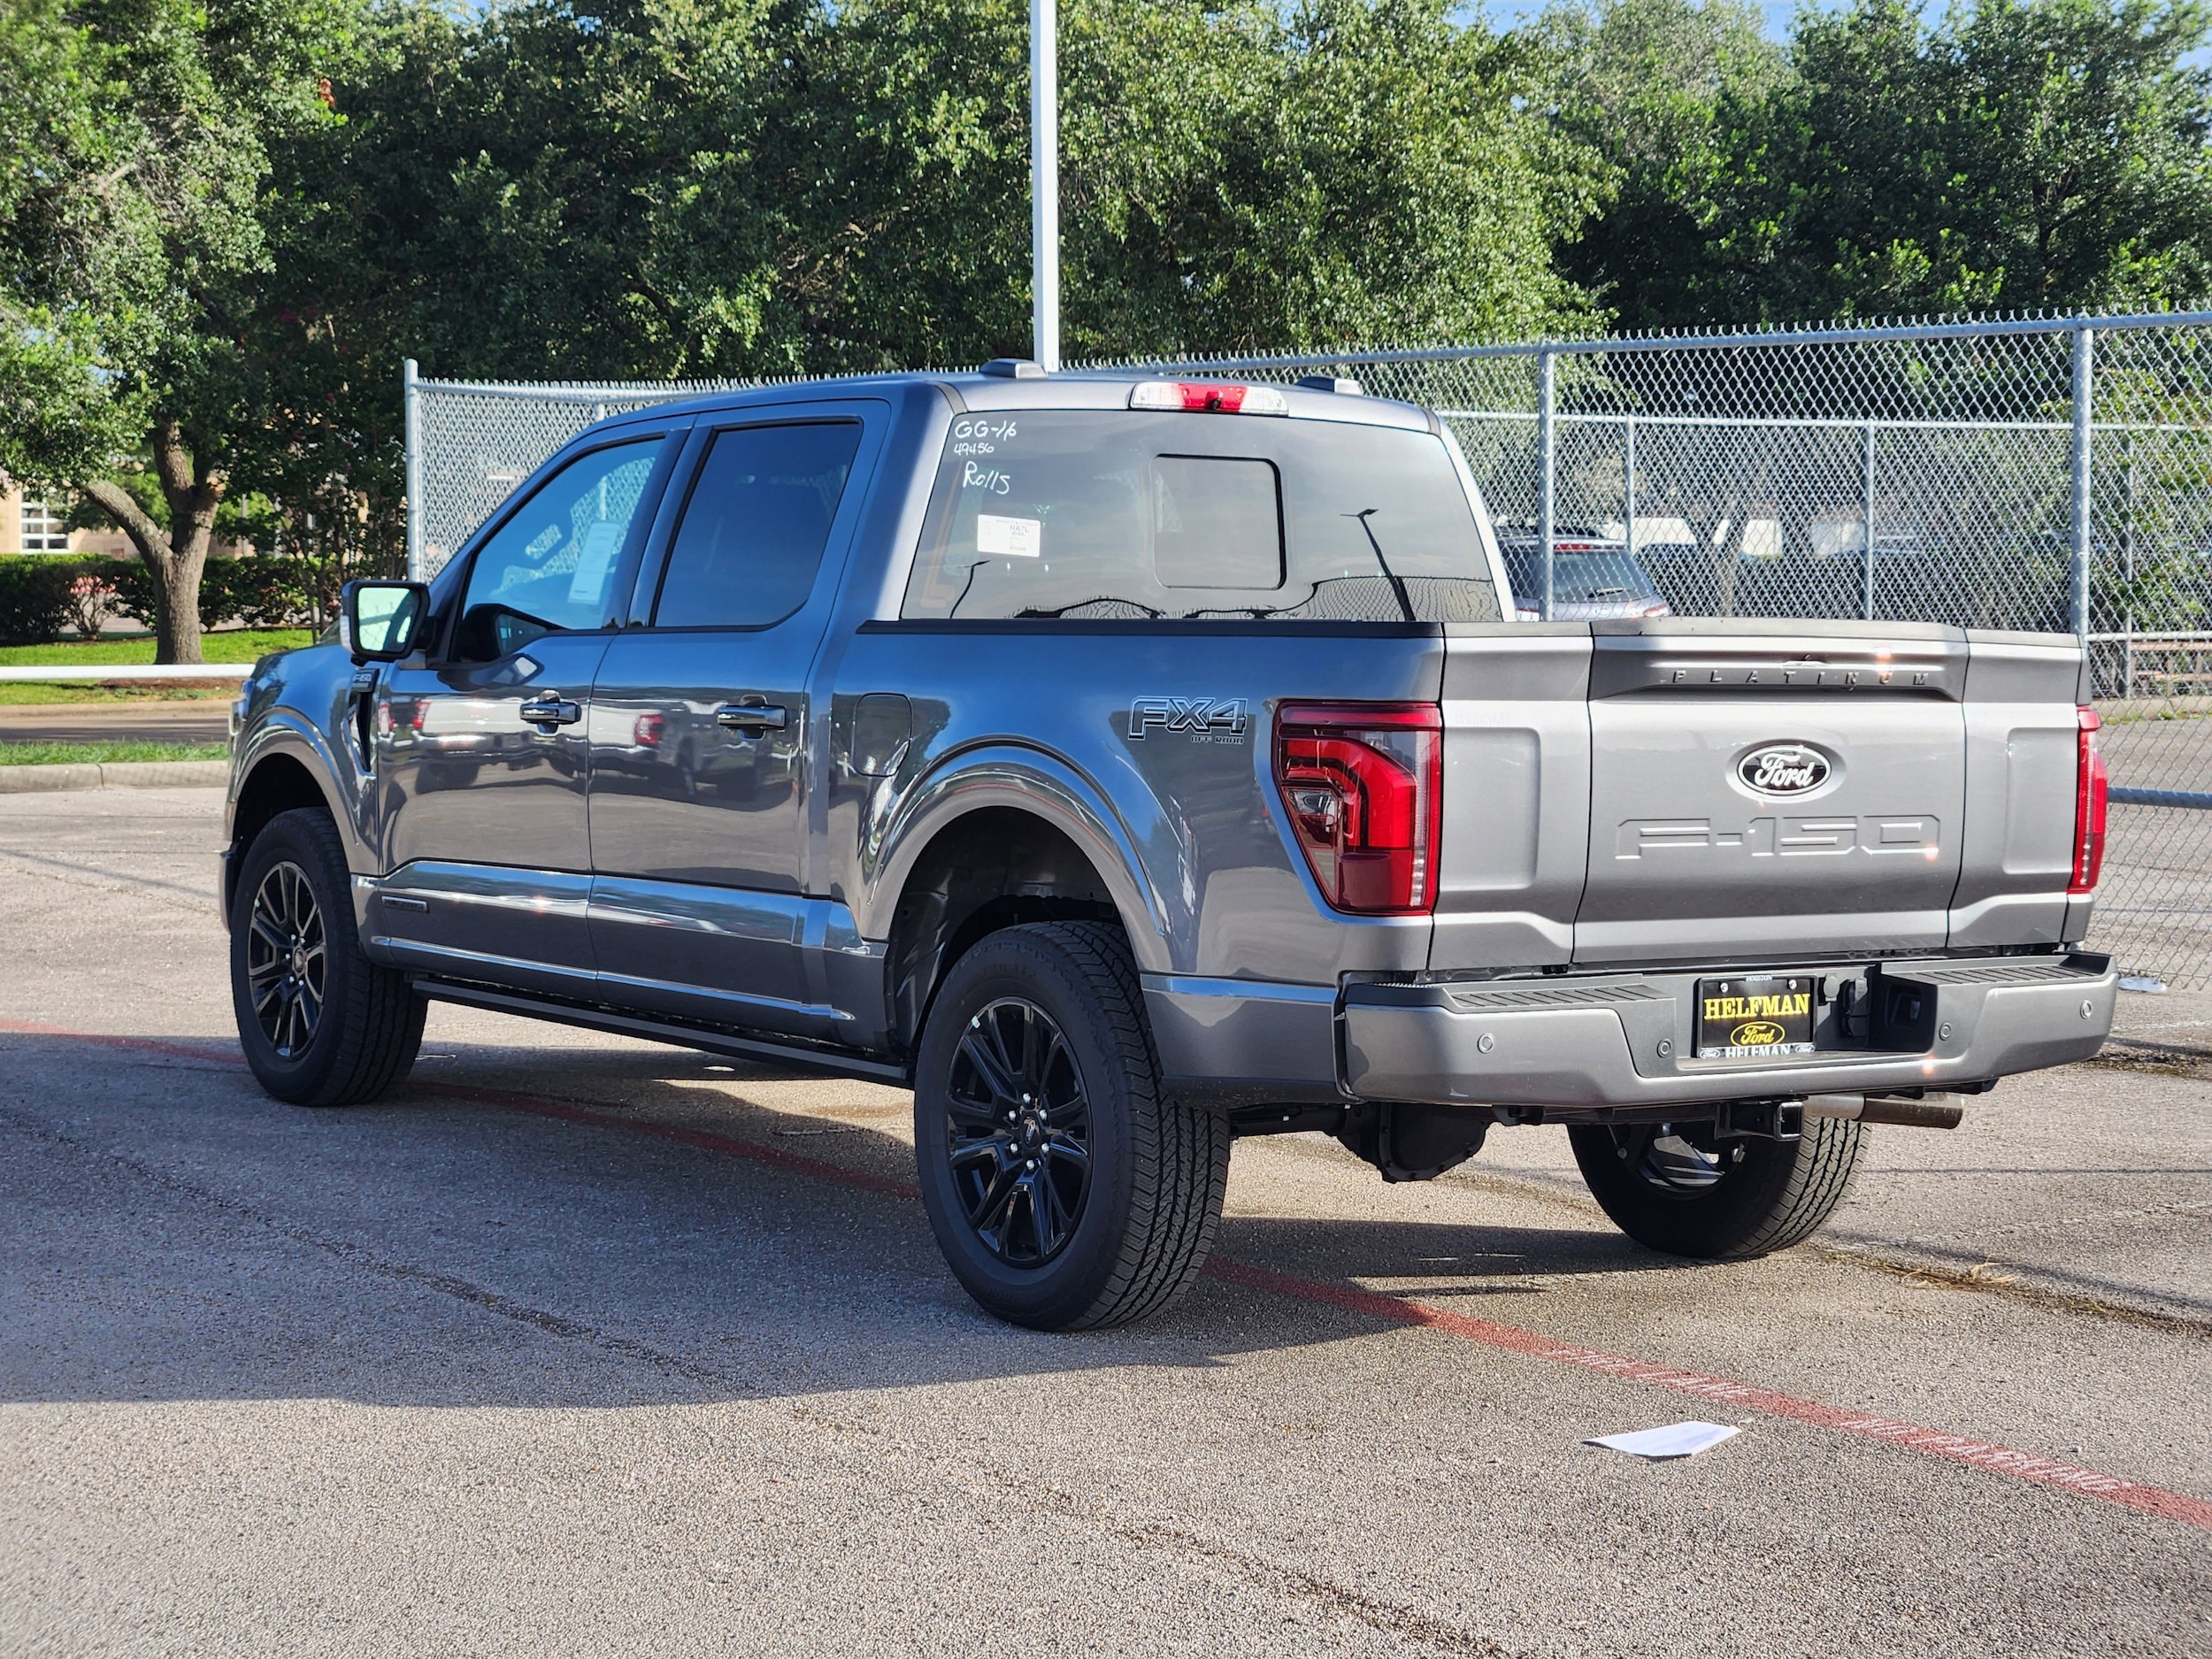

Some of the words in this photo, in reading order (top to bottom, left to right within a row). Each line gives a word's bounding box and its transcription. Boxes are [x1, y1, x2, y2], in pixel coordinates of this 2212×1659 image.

[954, 442, 995, 456] 49456
[963, 461, 1010, 495] Rolls
[1671, 669, 1930, 686] PLATINUM
[1128, 695, 1248, 741] FX4
[1215, 736, 1245, 745] ROAD
[1755, 751, 1815, 787] Ford
[1615, 815, 1940, 859] F-150
[1704, 994, 1811, 1019] HELFMAN
[1740, 1025, 1776, 1045] Ford
